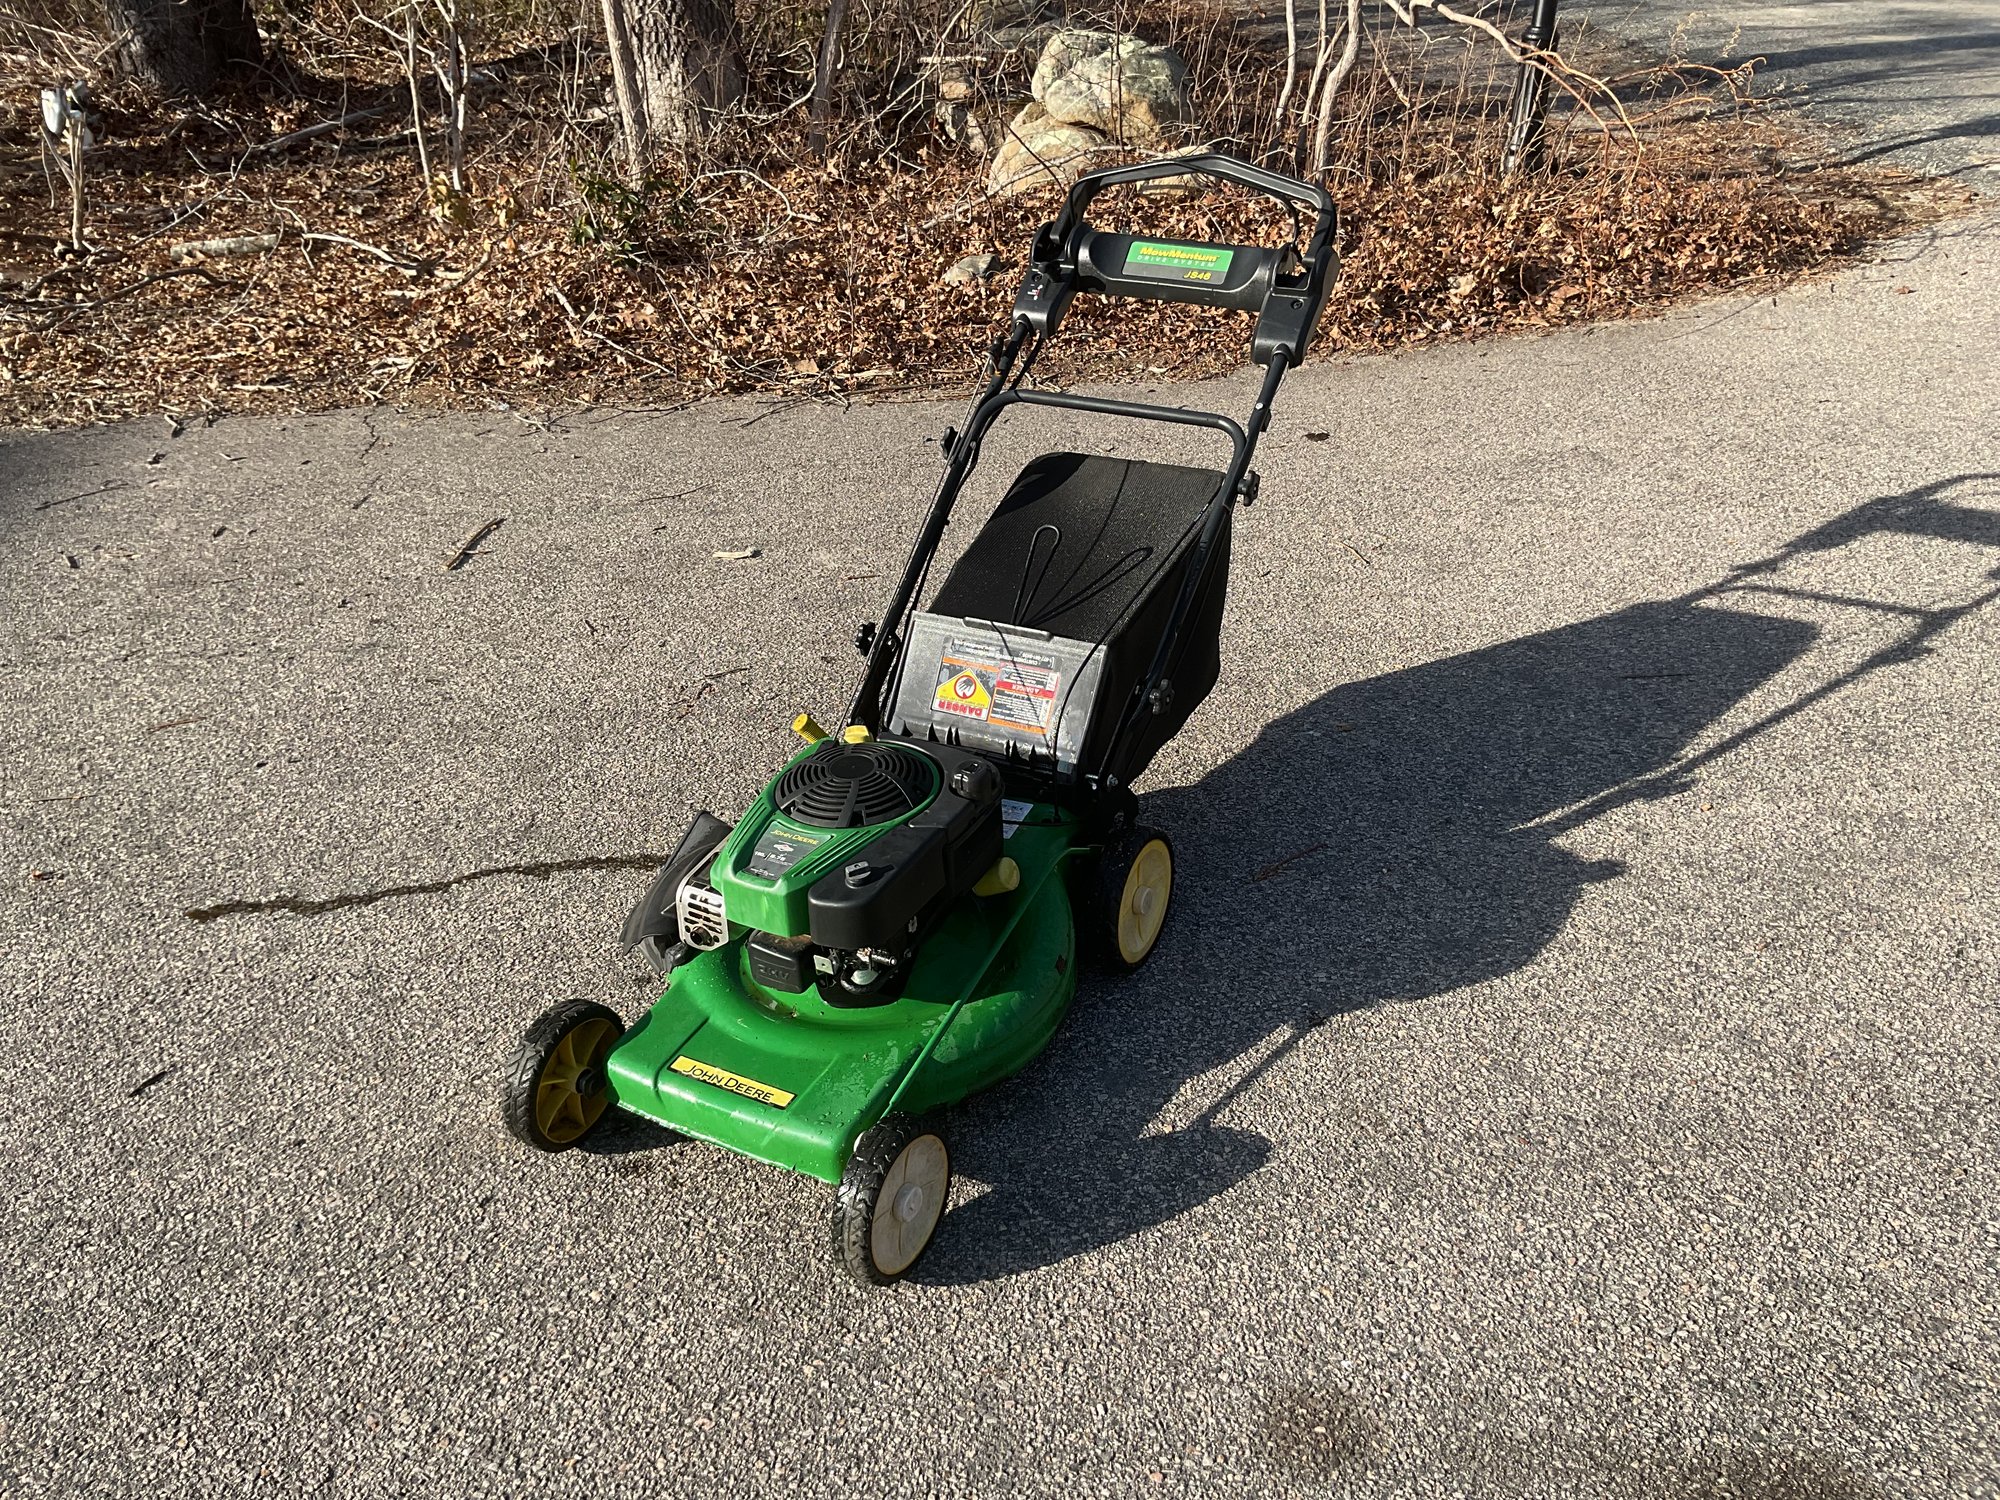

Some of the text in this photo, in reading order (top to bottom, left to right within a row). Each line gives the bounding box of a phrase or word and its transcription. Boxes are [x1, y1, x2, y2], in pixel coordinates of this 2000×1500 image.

[1137, 255, 1215, 267] DRIVE SYSTEM
[1012, 684, 1035, 694] DANGER
[938, 700, 983, 716] DANGER
[771, 829, 793, 839] JOHN
[792, 834, 819, 845] DEERE
[683, 1065, 774, 1102] JOHN DEERE
